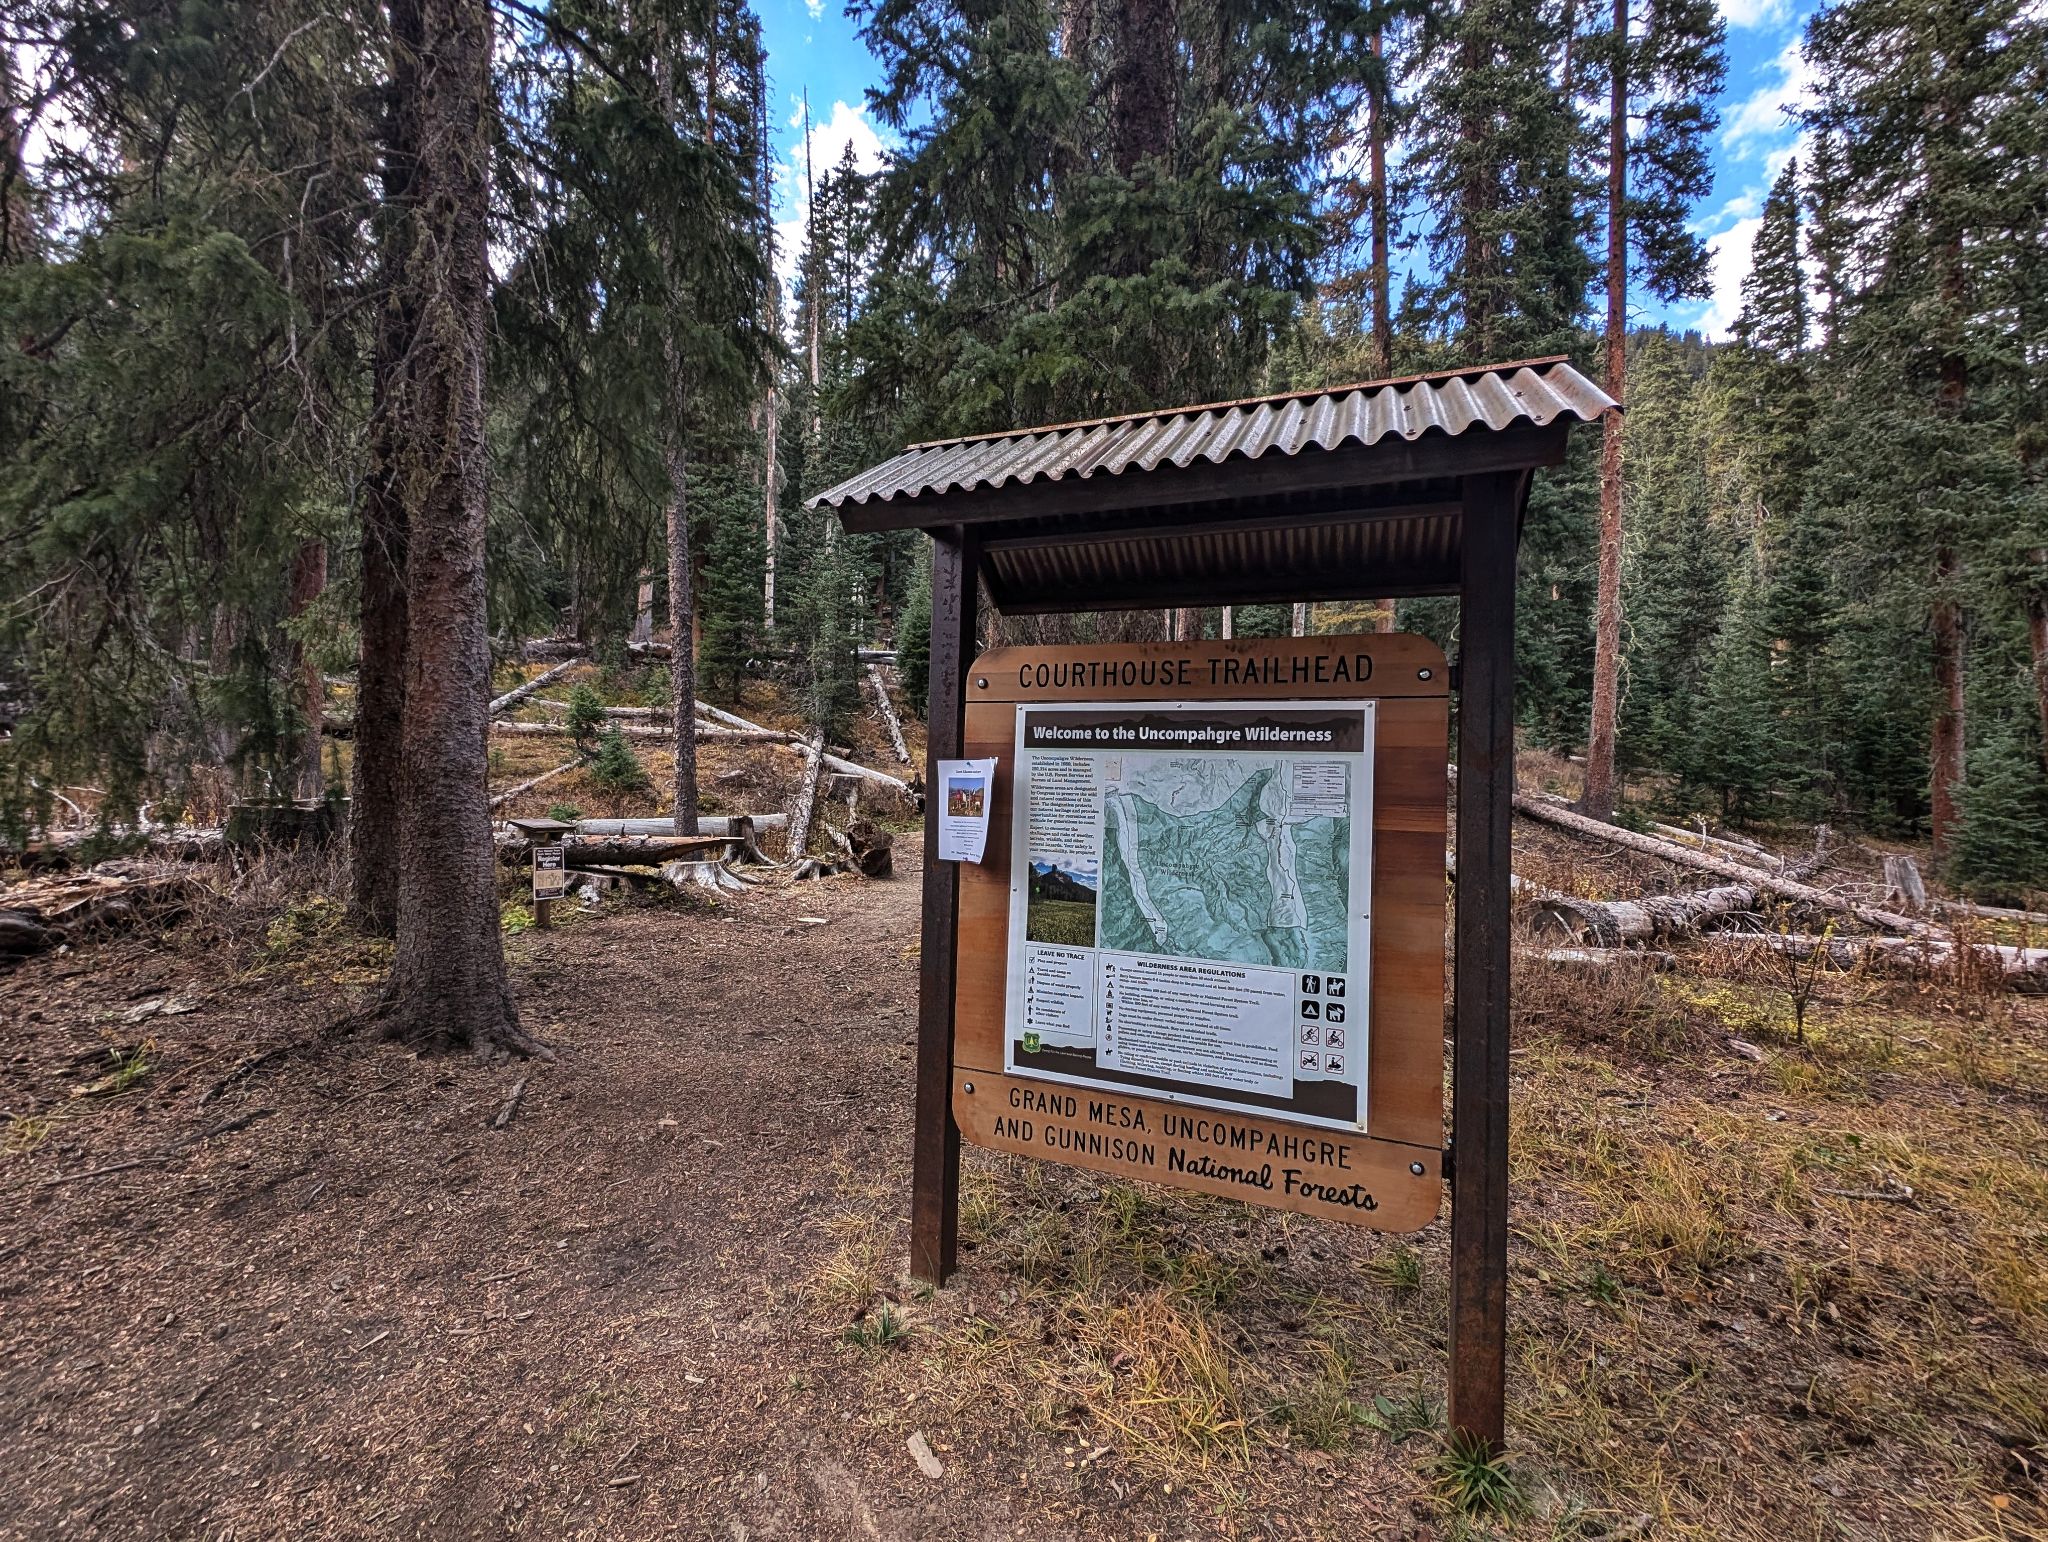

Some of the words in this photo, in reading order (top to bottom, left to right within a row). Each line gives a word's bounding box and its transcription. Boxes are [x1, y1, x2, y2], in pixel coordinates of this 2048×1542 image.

[1020, 660, 1192, 688] COURTHOUSE
[1208, 654, 1372, 684] TRAILHEAD
[1033, 726, 1092, 739] Welcome
[1095, 728, 1109, 739] to
[1112, 726, 1136, 740] the
[1139, 726, 1241, 743] Uncompahgre
[1245, 727, 1332, 740] Wilderness
[1137, 961, 1177, 971] WILDERNESS
[1179, 966, 1197, 974] AREA
[1198, 968, 1246, 978] REGULATIONS
[1009, 1087, 1076, 1117] GRAND
[1089, 1100, 1152, 1134] MESA,
[1164, 1114, 1352, 1170] UNCOMPAHGRE
[994, 1116, 1033, 1141] AND
[1045, 1125, 1154, 1165] GUNNISON
[1168, 1147, 1273, 1190] National
[1282, 1169, 1378, 1211] Forests
